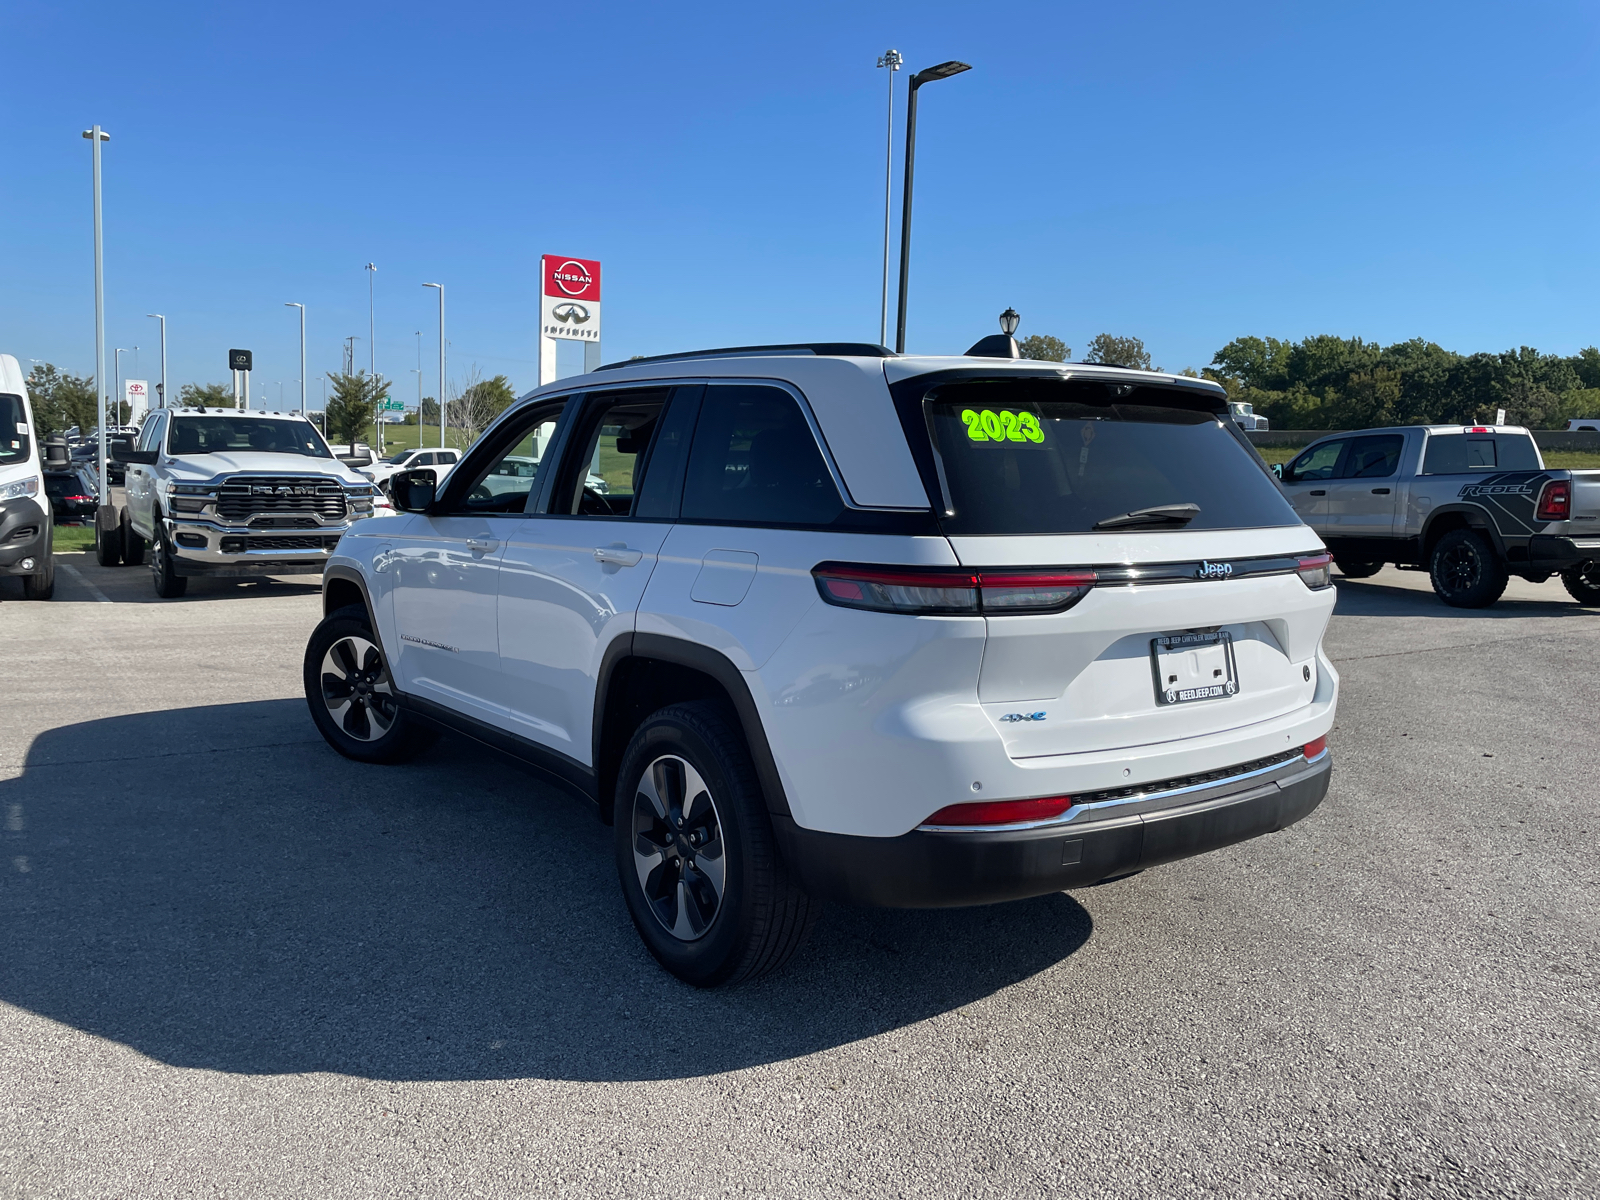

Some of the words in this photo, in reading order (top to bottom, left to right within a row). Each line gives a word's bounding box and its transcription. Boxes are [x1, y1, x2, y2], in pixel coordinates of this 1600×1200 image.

[554, 272, 592, 283] NISSAN
[544, 325, 598, 339] INFINITI
[961, 409, 1045, 444] 2023
[252, 485, 315, 495] RAM
[1457, 484, 1533, 498] REBEL
[1199, 559, 1233, 580] Jeep
[1170, 636, 1182, 644] JEEP
[1182, 634, 1204, 643] CHRYSLER
[1179, 685, 1224, 701] REEDJEEP.COM
